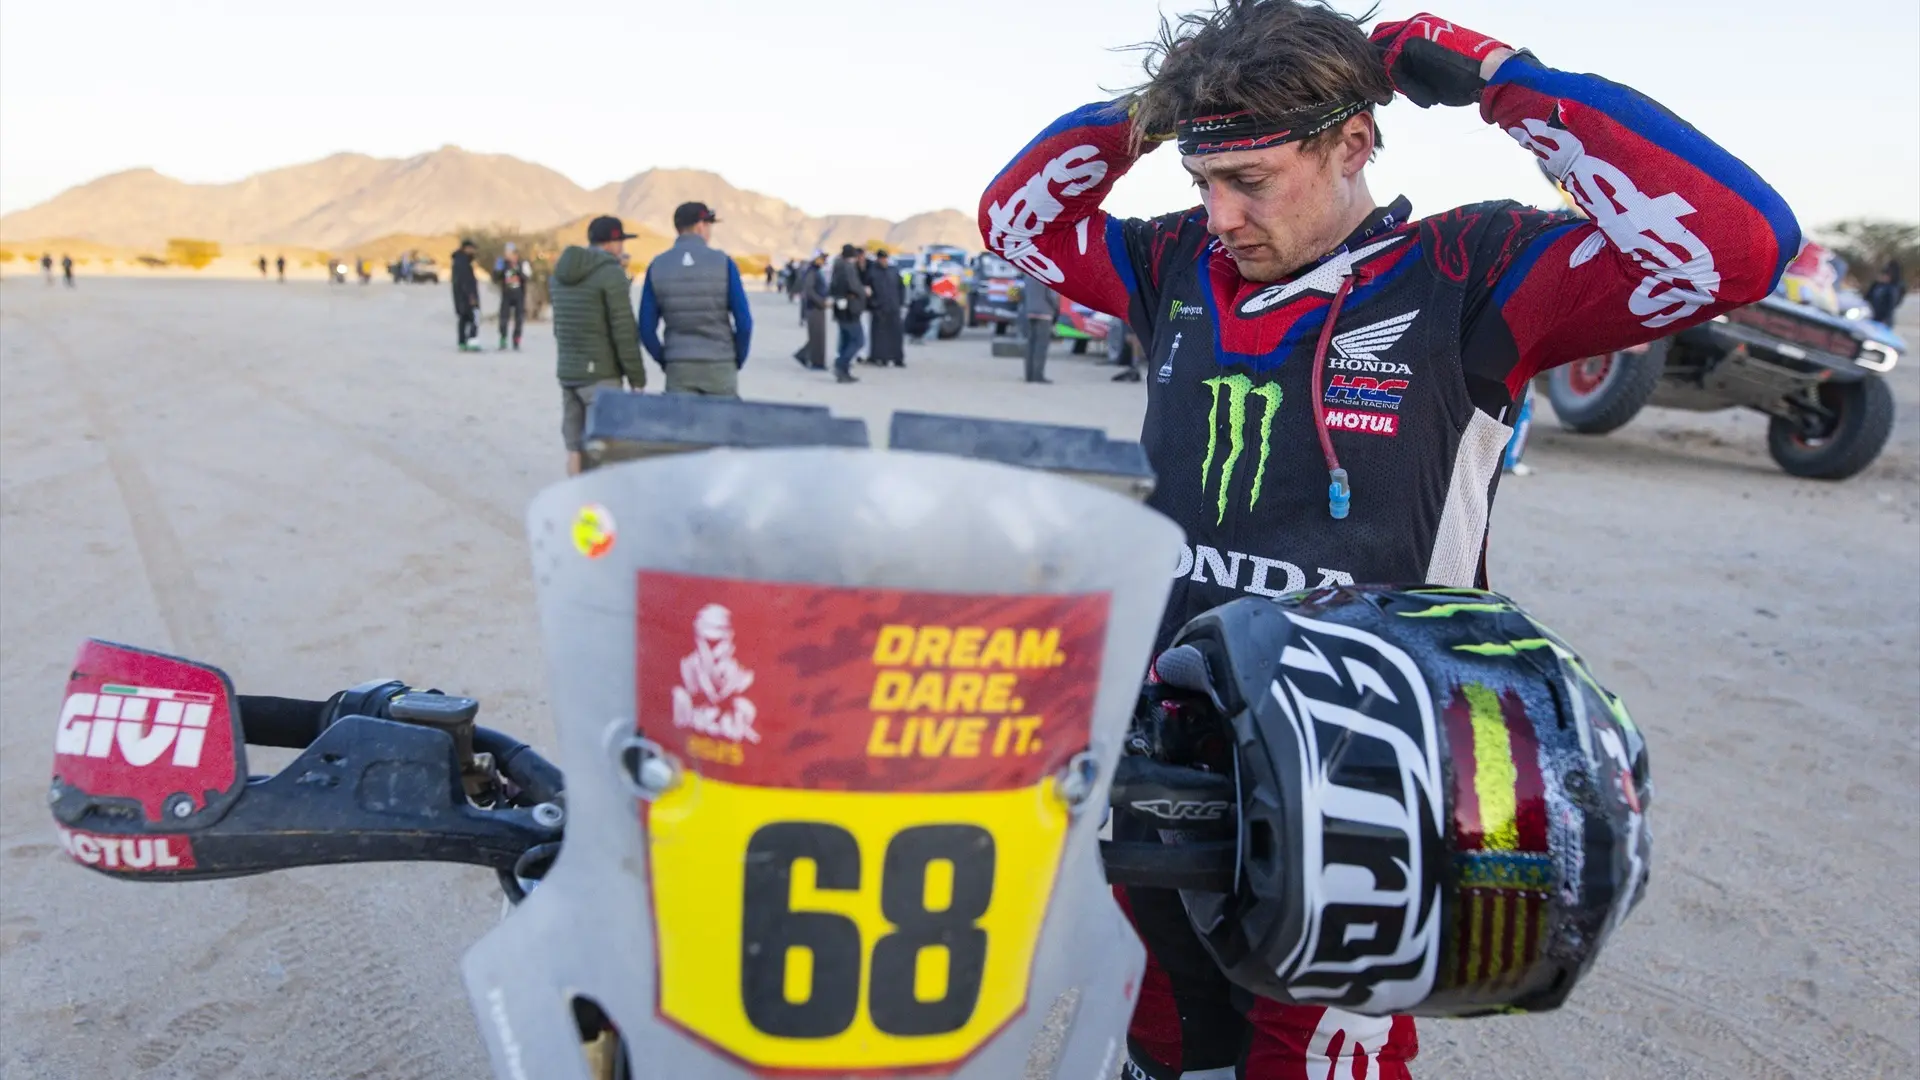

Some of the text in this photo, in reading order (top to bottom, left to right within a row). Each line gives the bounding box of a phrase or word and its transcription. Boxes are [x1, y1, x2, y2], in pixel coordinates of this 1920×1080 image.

[1328, 358, 1413, 375] HONDA
[1325, 374, 1410, 404] HRC
[1360, 401, 1399, 410] RACING
[1325, 411, 1394, 433] MOTUL
[873, 625, 1067, 668] DREAM.
[868, 670, 1025, 713] DARE.
[56, 692, 214, 768] GIVI
[866, 715, 1043, 758] LIVE IT.
[1131, 799, 1228, 819] ARC
[740, 820, 996, 1039] 68
